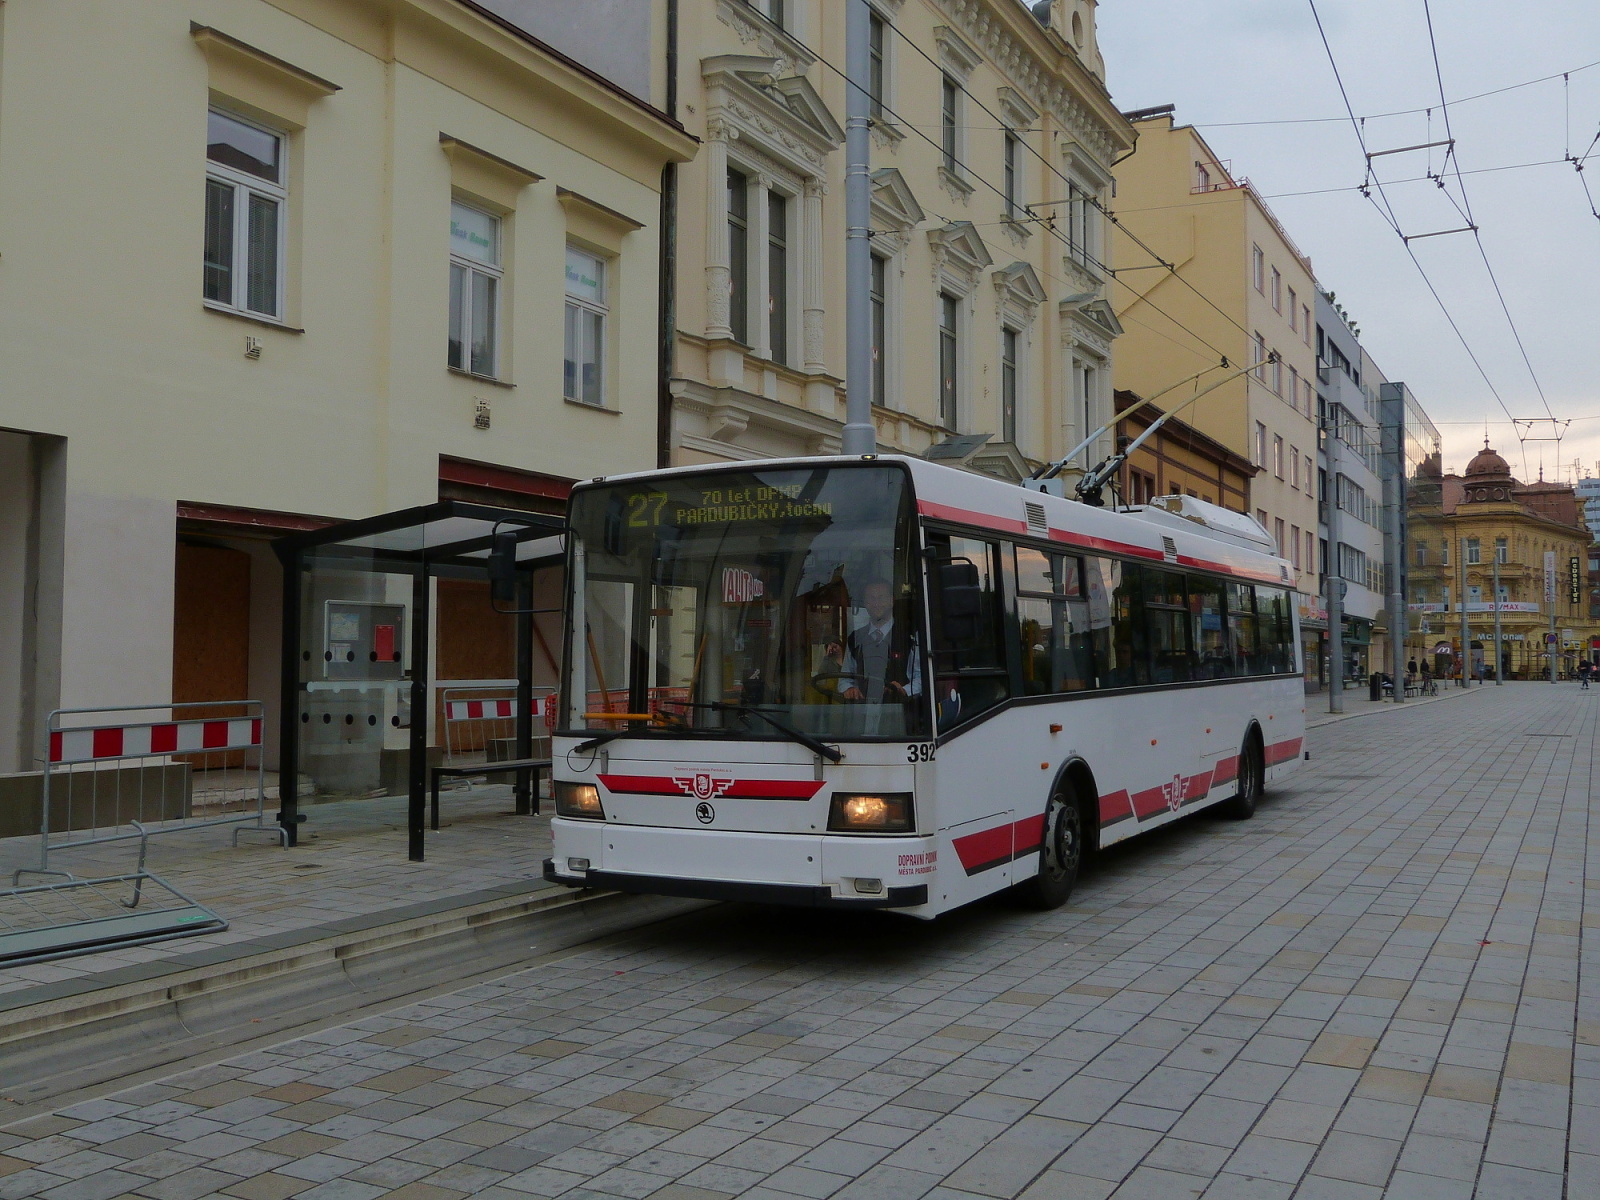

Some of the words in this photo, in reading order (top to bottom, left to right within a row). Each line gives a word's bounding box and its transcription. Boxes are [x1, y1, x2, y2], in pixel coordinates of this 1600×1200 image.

[701, 490, 721, 505] 70
[728, 488, 750, 503] let
[627, 492, 668, 527] 27
[907, 743, 936, 763] 392
[898, 850, 924, 867] DOPRAVNÍ
[898, 867, 914, 875] MĚSTA
